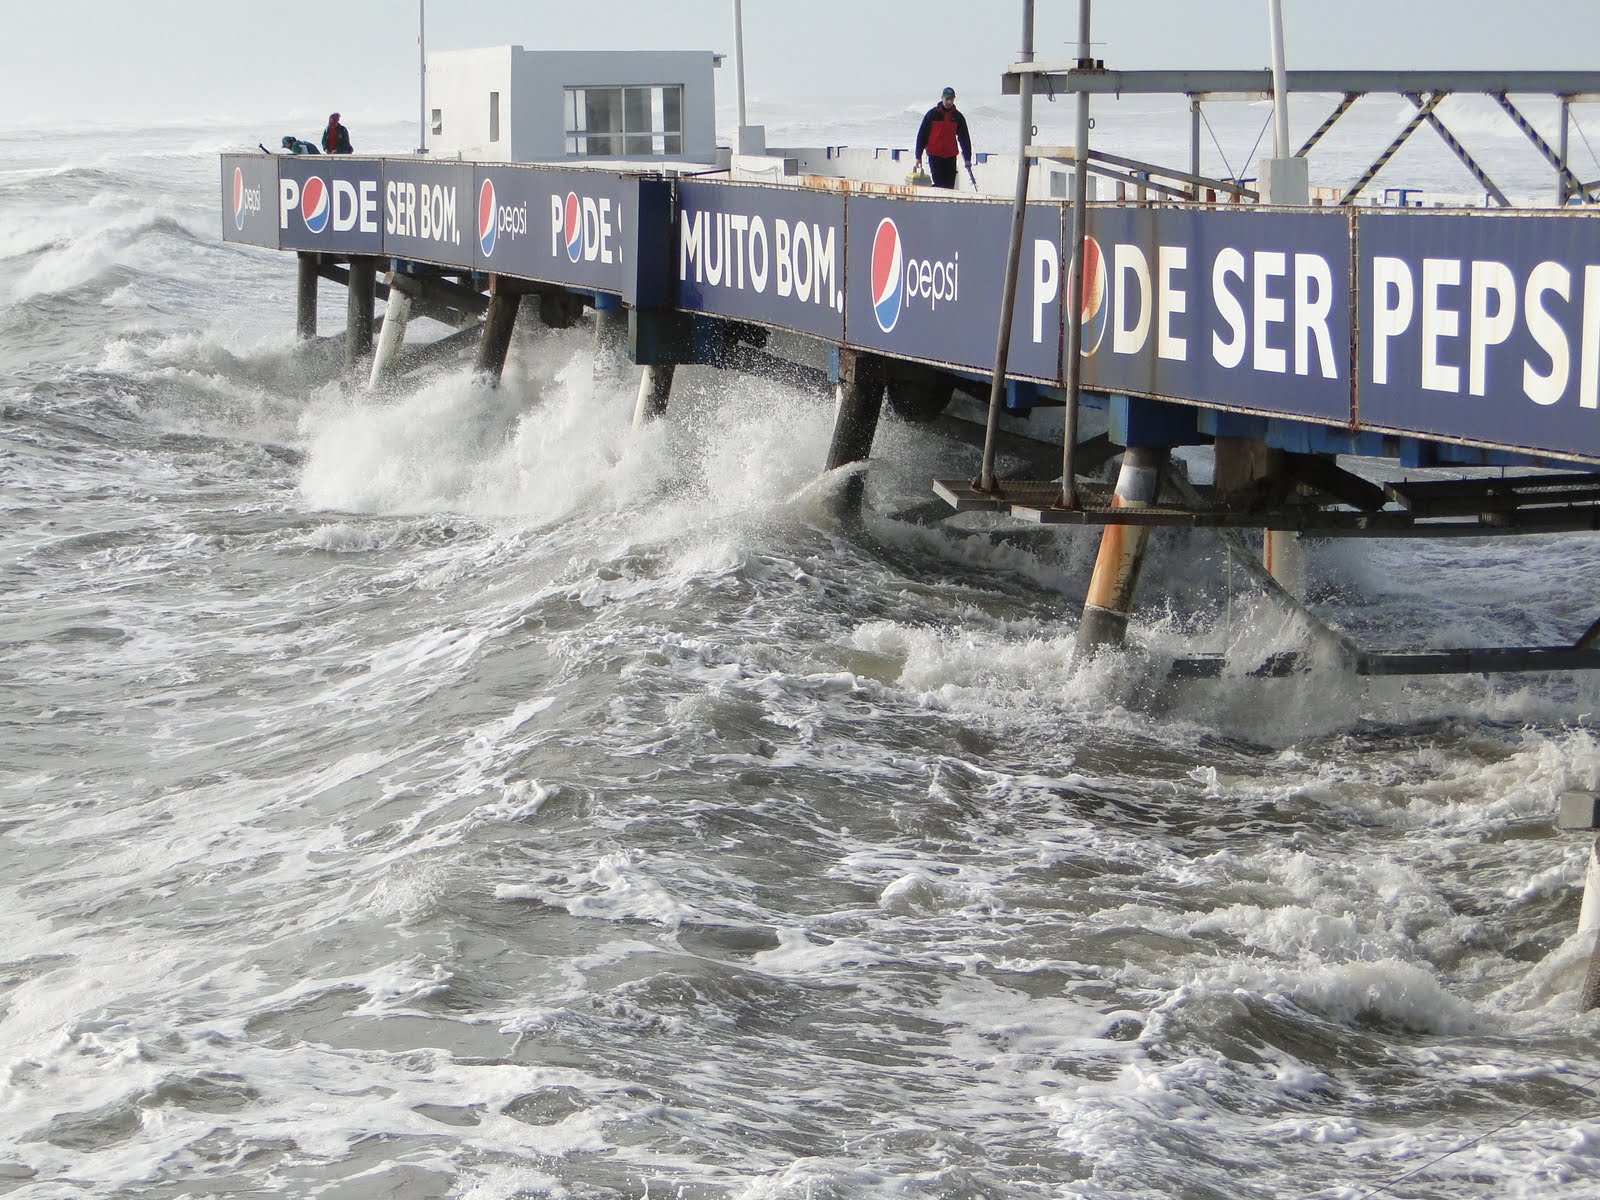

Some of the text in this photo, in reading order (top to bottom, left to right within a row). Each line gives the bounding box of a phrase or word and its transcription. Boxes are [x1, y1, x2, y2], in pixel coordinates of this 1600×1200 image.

[244, 184, 261, 217] pepsi
[280, 176, 461, 245] PODE SER BOM.
[497, 201, 527, 240] pepsi
[551, 191, 612, 263] PODE
[680, 210, 768, 293] MUITO
[775, 218, 843, 314] BOM.
[906, 251, 959, 311] pepsi
[1033, 235, 1600, 409] PODE SER PEPSI
